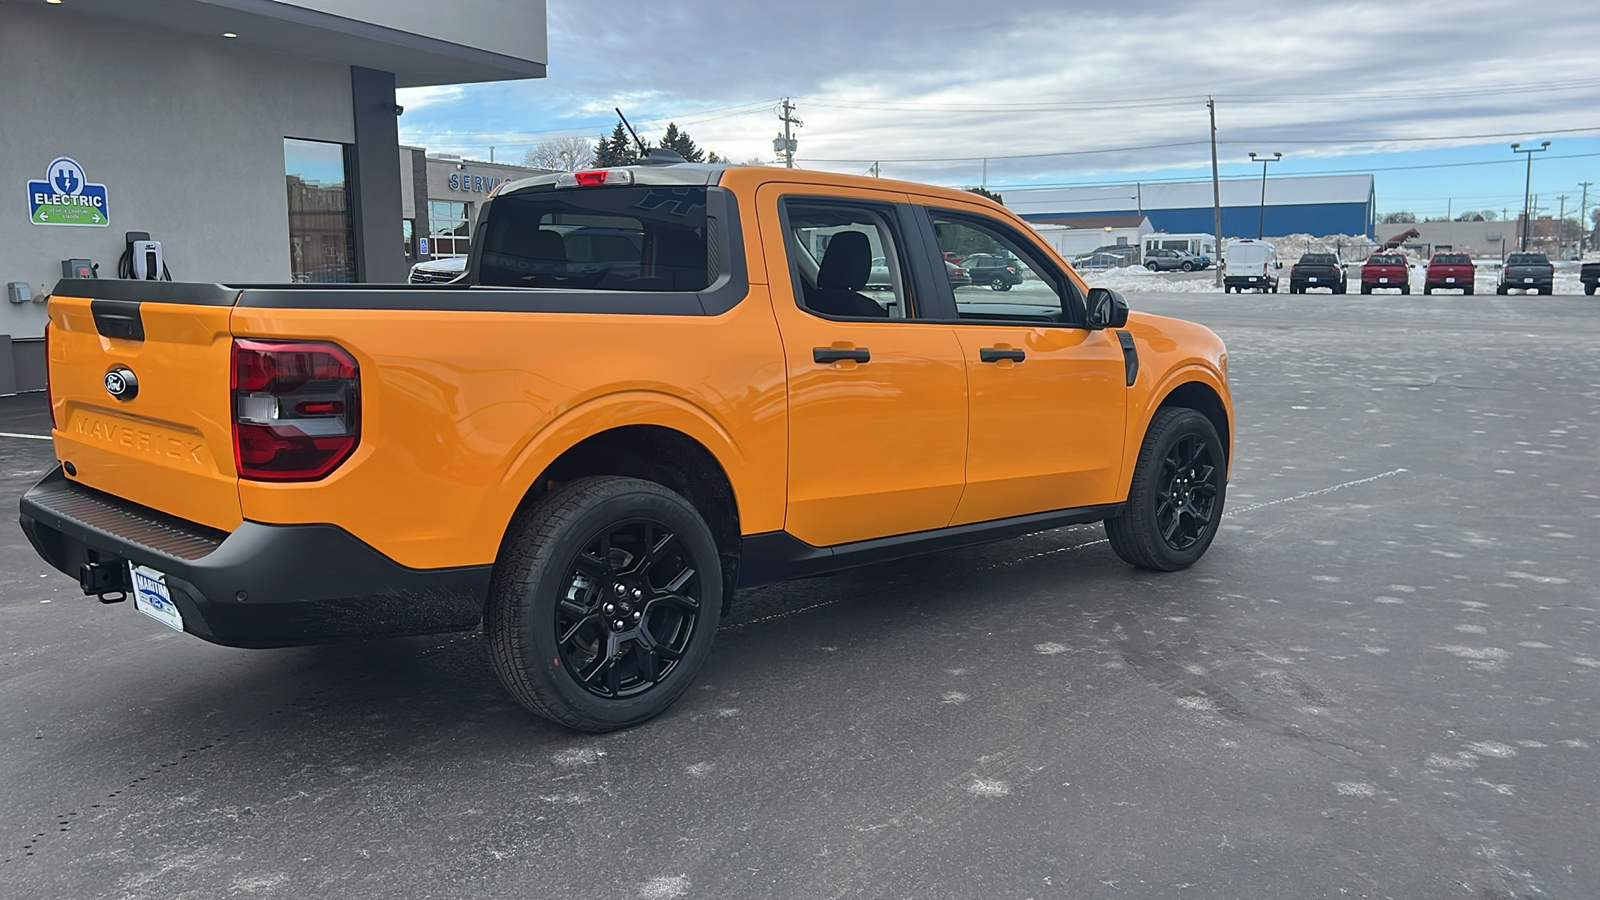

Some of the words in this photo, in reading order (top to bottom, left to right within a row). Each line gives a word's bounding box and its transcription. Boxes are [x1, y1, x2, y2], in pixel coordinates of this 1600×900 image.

[449, 173, 512, 193] SERV
[34, 193, 103, 207] ELECTRIC
[75, 415, 203, 465] MAVERICK
[136, 574, 170, 601] MARITIM
